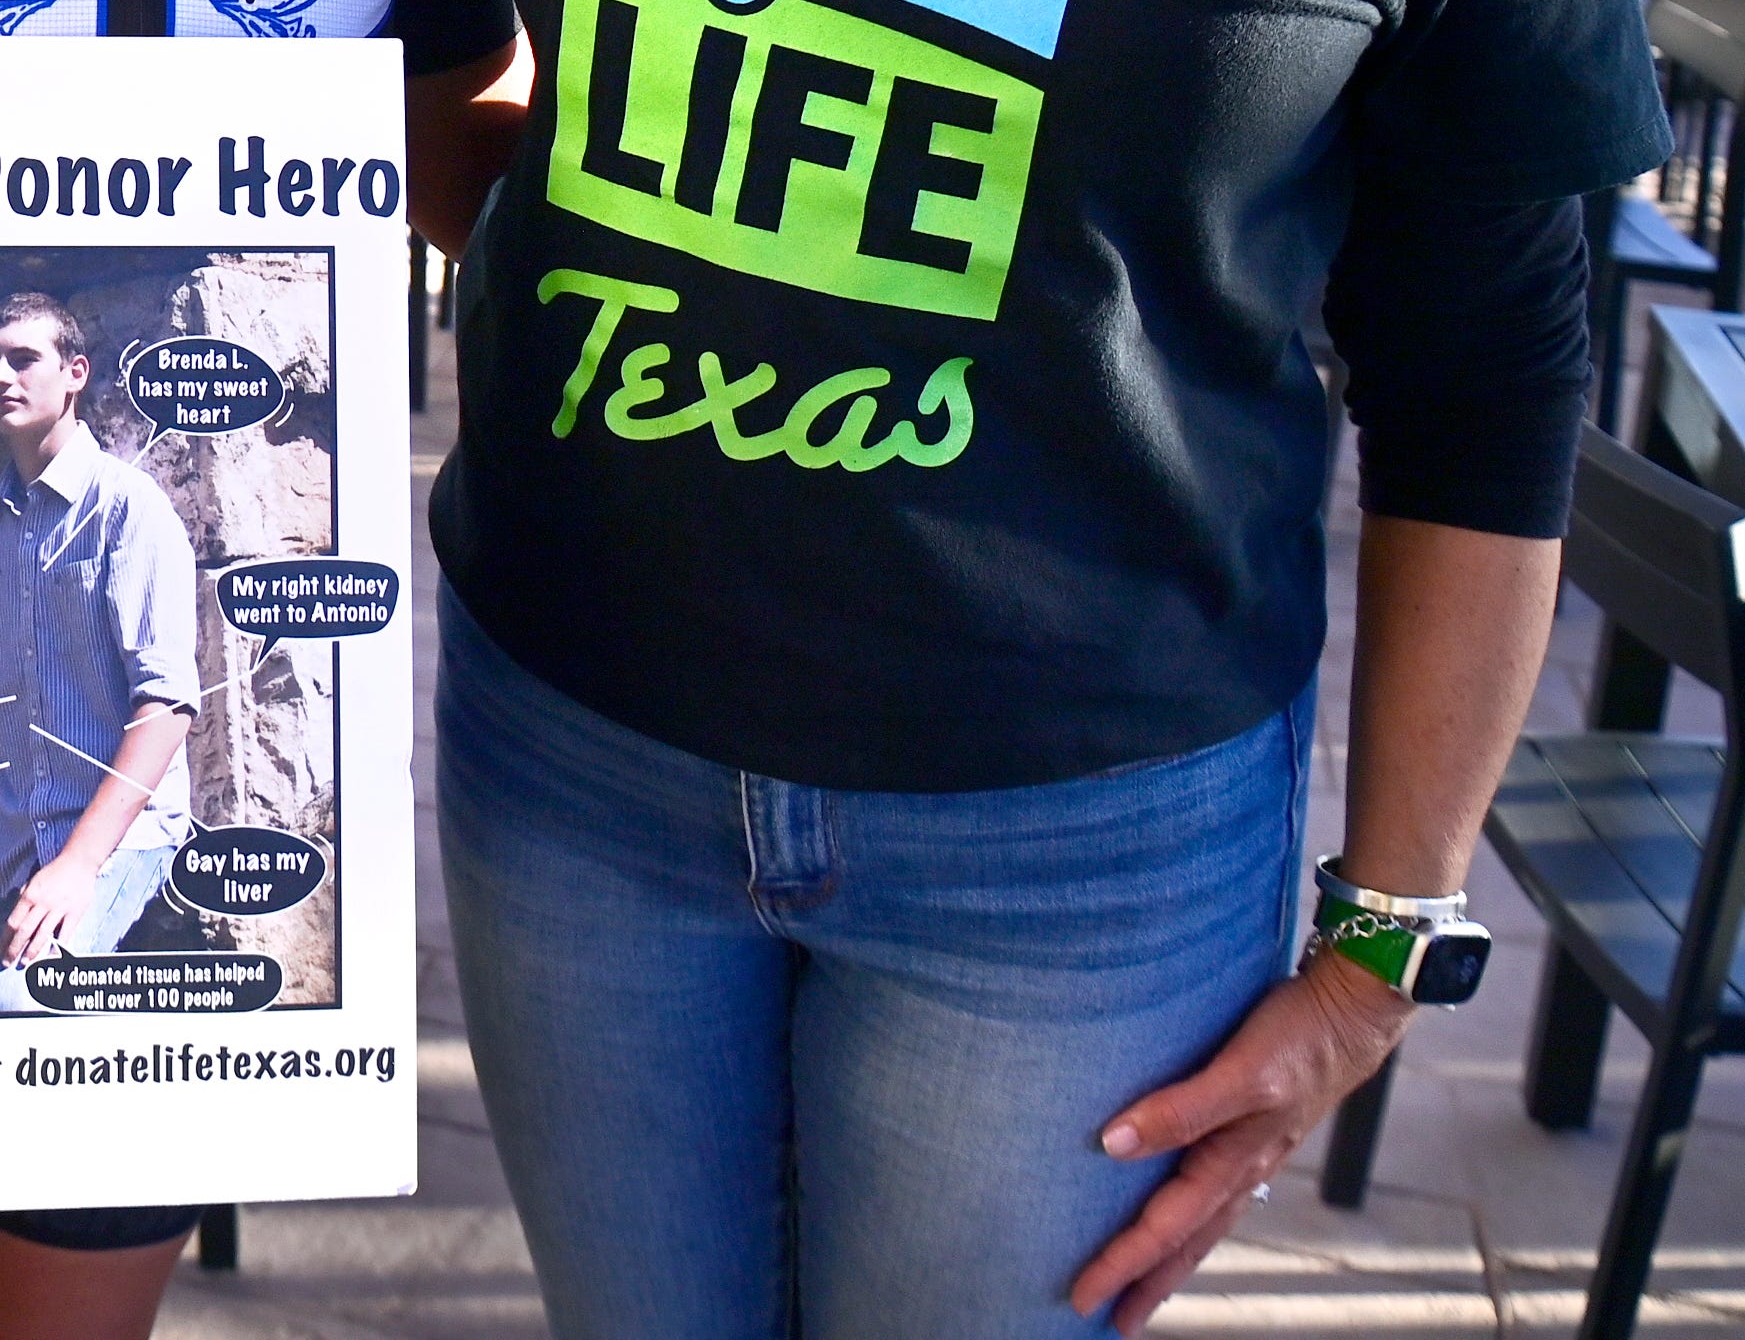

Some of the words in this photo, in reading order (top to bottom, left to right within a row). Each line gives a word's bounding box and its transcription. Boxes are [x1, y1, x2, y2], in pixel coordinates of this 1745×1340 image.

[218, 135, 400, 219] Hero
[158, 348, 227, 370] Brenda
[232, 348, 249, 370] L.
[536, 268, 975, 473] Texas
[138, 375, 173, 397] has
[177, 380, 208, 401] my
[213, 377, 269, 397] sweet
[176, 402, 231, 425] heart
[232, 575, 267, 600] My
[271, 573, 320, 600] right
[324, 573, 389, 598] kidney
[233, 604, 281, 624] went
[286, 603, 307, 623] to
[310, 601, 388, 623] Antonio
[185, 848, 227, 877] Gay
[232, 847, 271, 872] has
[276, 852, 311, 875] my
[224, 878, 273, 903] liver
[37, 966, 66, 990] My
[68, 964, 132, 987] donated
[135, 965, 181, 985] tissue
[184, 962, 212, 983] has
[214, 961, 265, 986] helped
[73, 989, 104, 1010] well
[107, 993, 142, 1010] over
[147, 987, 180, 1008] 100
[183, 986, 234, 1012] people
[15, 1043, 395, 1087] donatelifetexas.org
